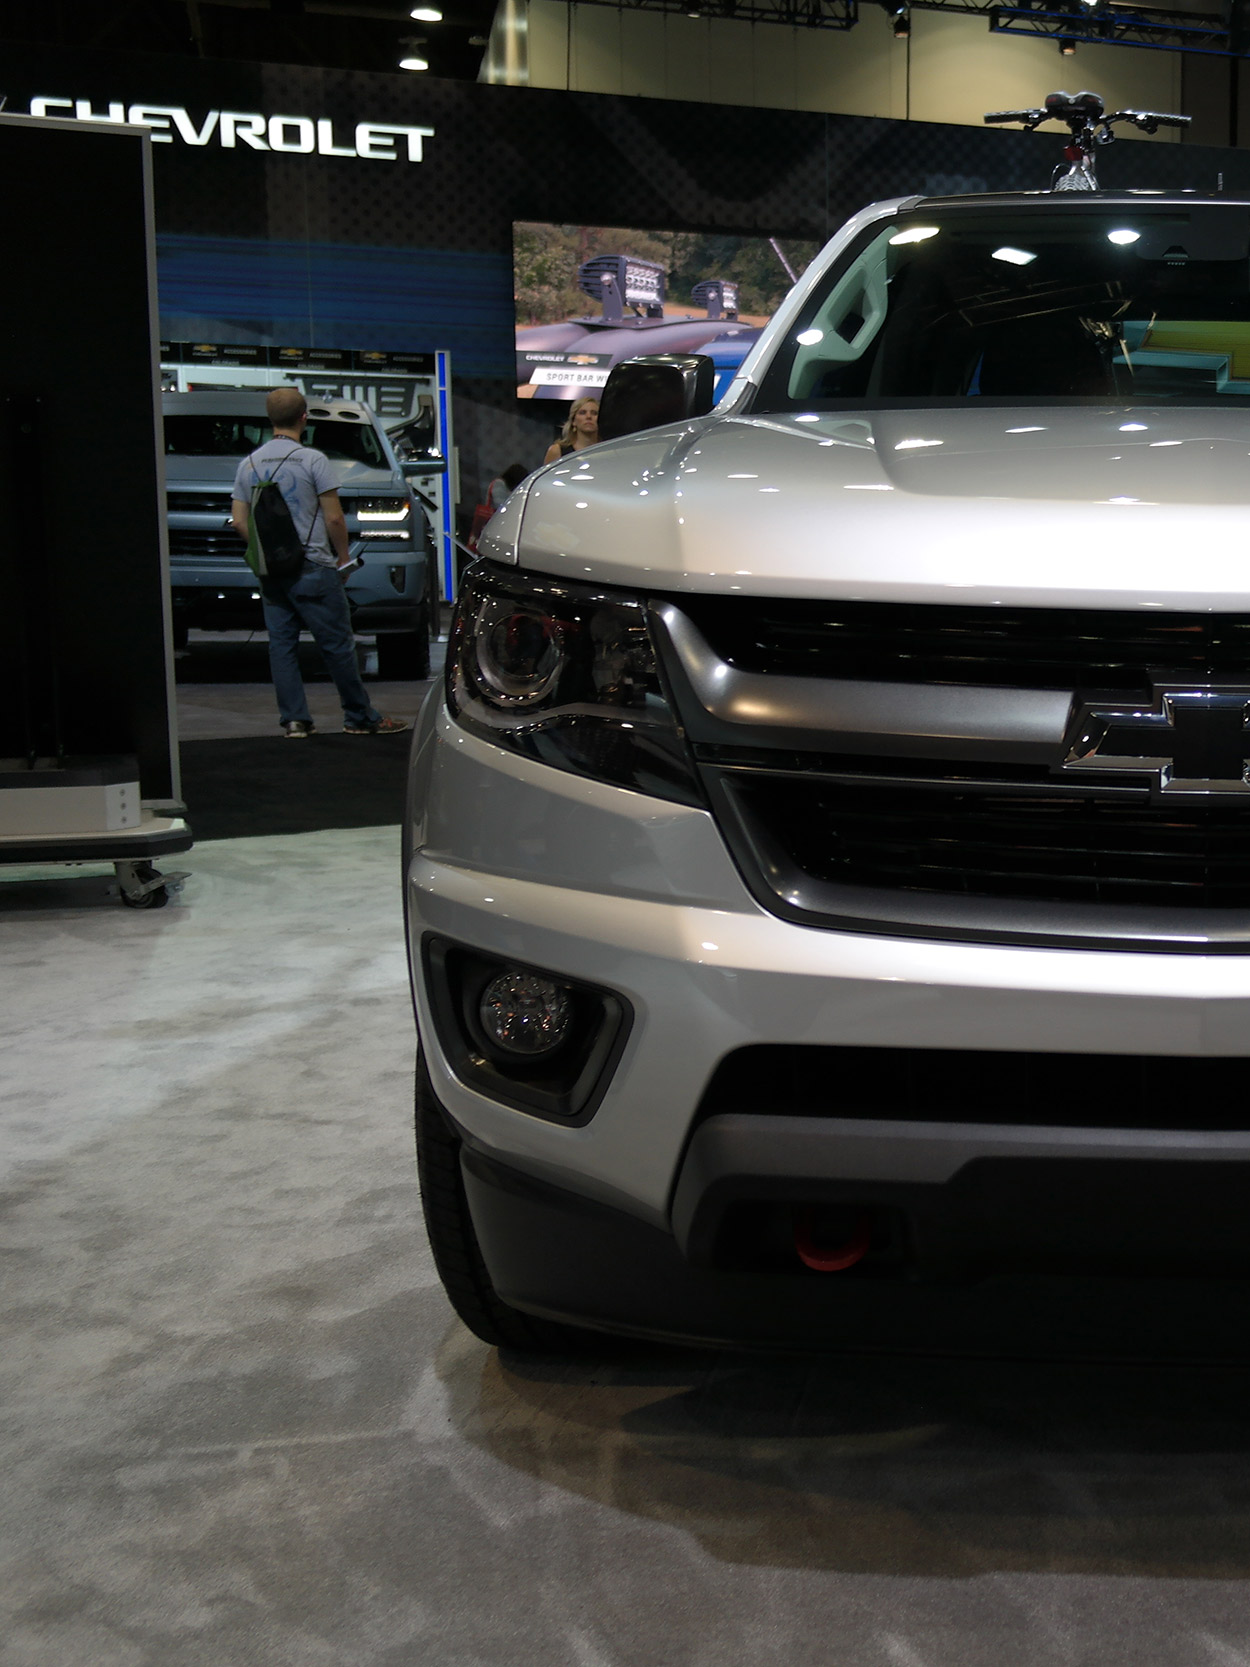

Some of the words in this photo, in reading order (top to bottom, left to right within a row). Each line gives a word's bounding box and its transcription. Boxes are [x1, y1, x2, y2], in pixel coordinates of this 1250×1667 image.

[30, 96, 435, 163] CHEVROLET
[525, 354, 565, 362] CHEVROLET
[546, 373, 575, 382] SPORT
[577, 374, 594, 383] BAR
